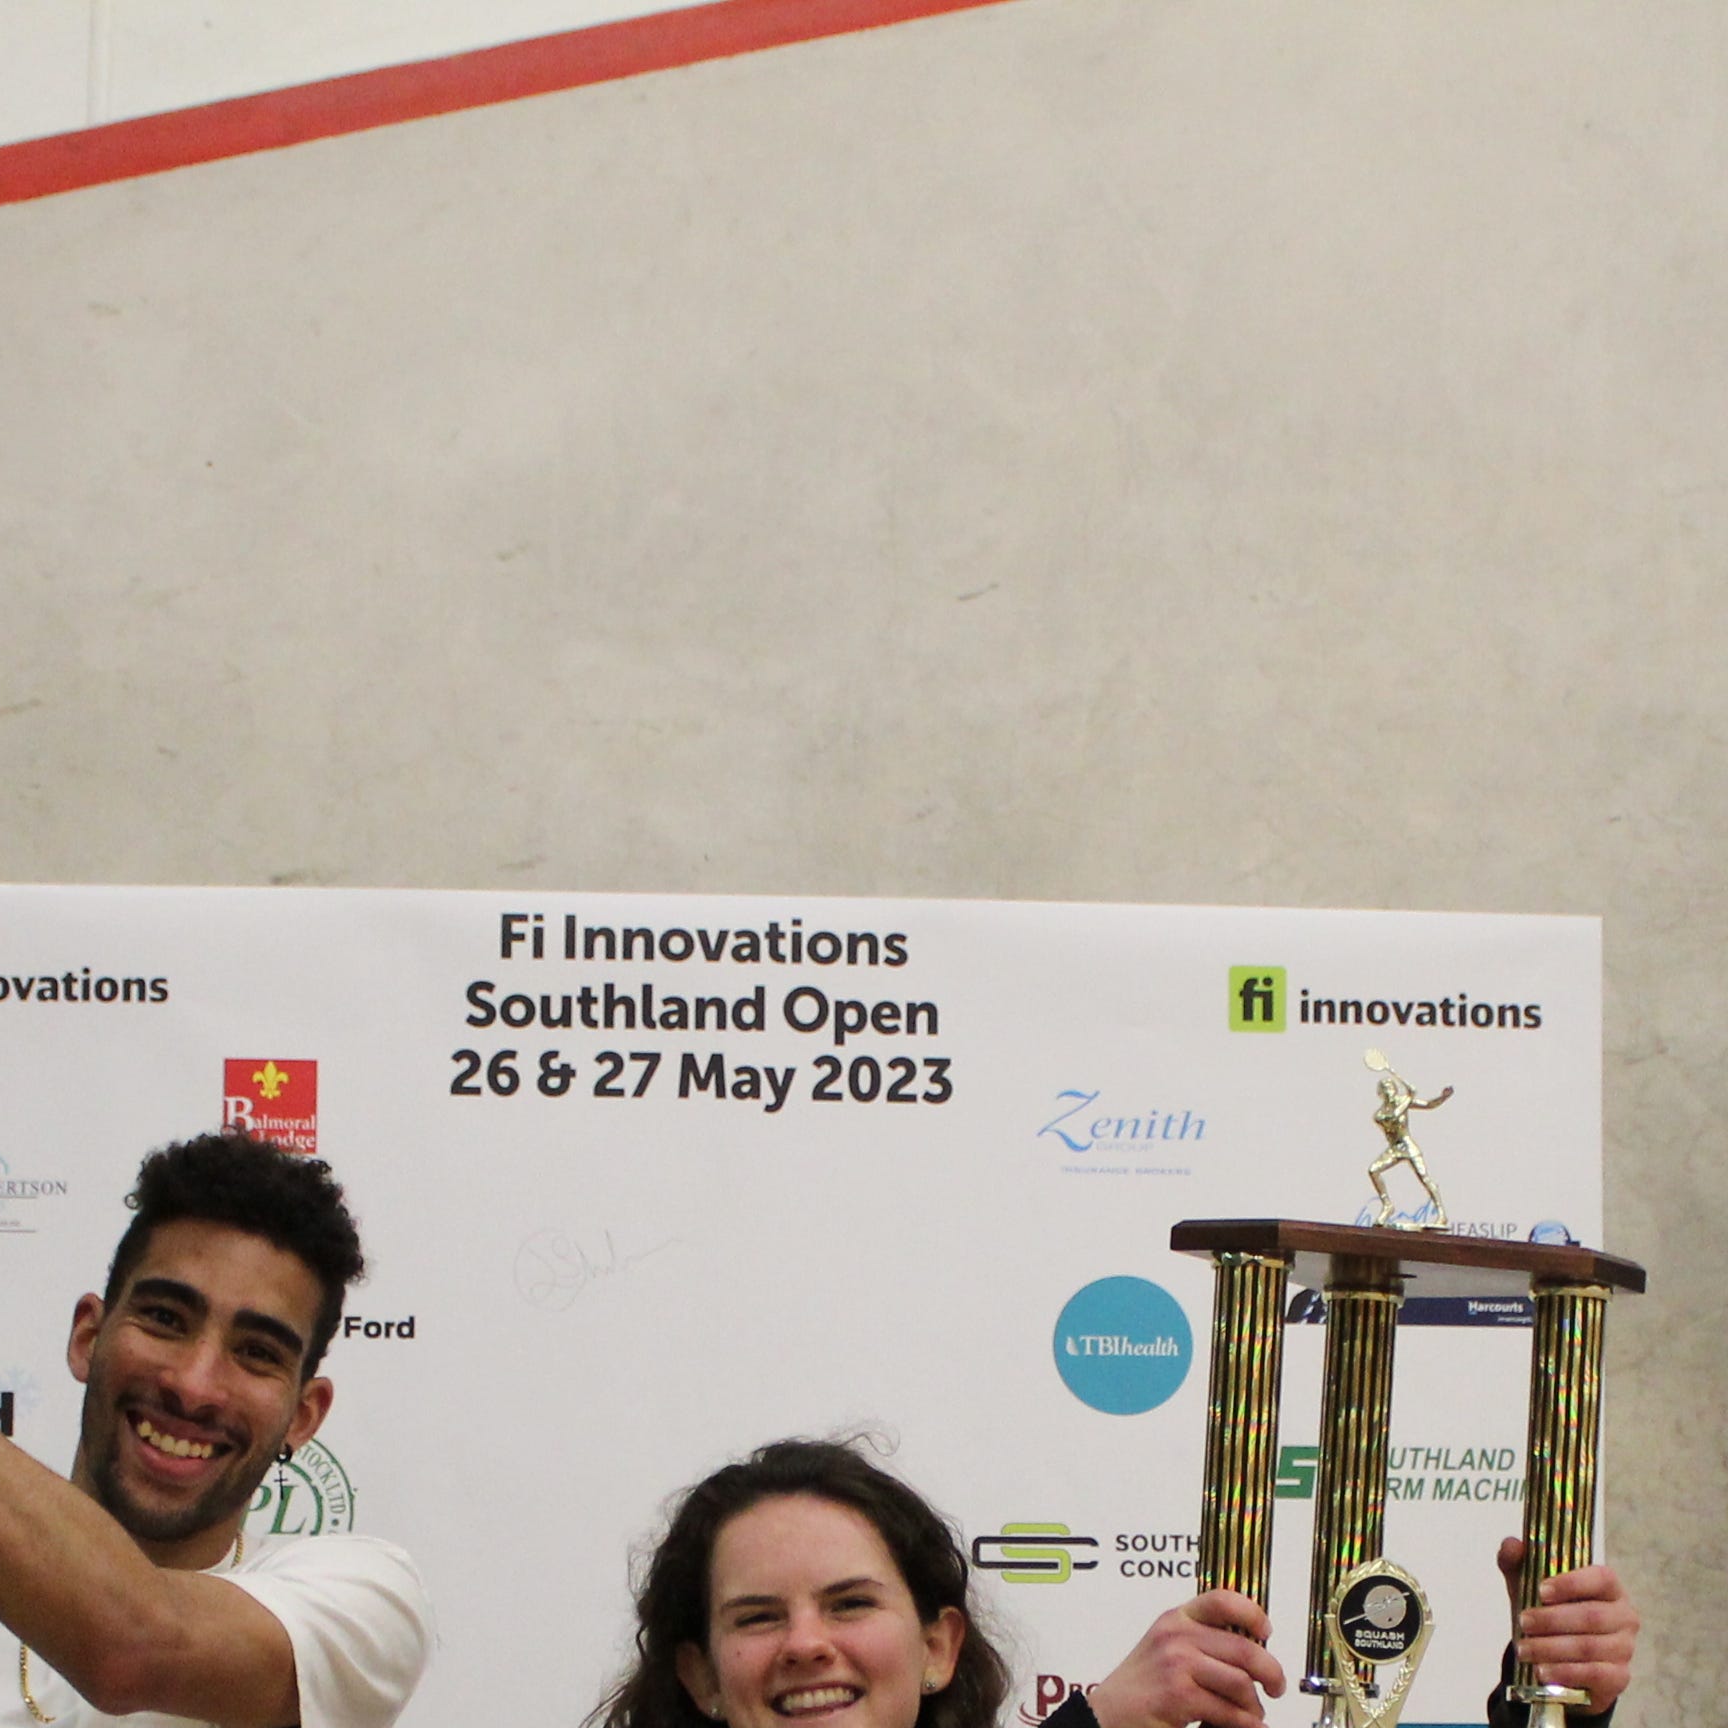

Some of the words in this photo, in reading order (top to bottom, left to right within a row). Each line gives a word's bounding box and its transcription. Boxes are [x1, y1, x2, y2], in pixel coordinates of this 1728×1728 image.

[500, 914, 545, 960] Fi
[563, 914, 909, 967] Innovations
[465, 981, 766, 1032] Southland
[782, 986, 939, 1045] Open
[1300, 989, 1542, 1029] innovations
[450, 1050, 520, 1097] 26
[537, 1051, 577, 1098] &
[593, 1051, 662, 1099] 27
[678, 1052, 795, 1113] May
[812, 1056, 953, 1104] 2023
[224, 1096, 316, 1135] Balmoral
[1036, 1089, 1207, 1152] Zenith
[1468, 1301, 1523, 1312] Harcourts
[344, 1316, 415, 1339] Ford
[1080, 1336, 1178, 1356] TBIhealth
[1120, 1561, 1200, 1577] CONC
[1355, 1630, 1405, 1640] SQUASH
[1355, 1639, 1404, 1649] SOUTHLAND
